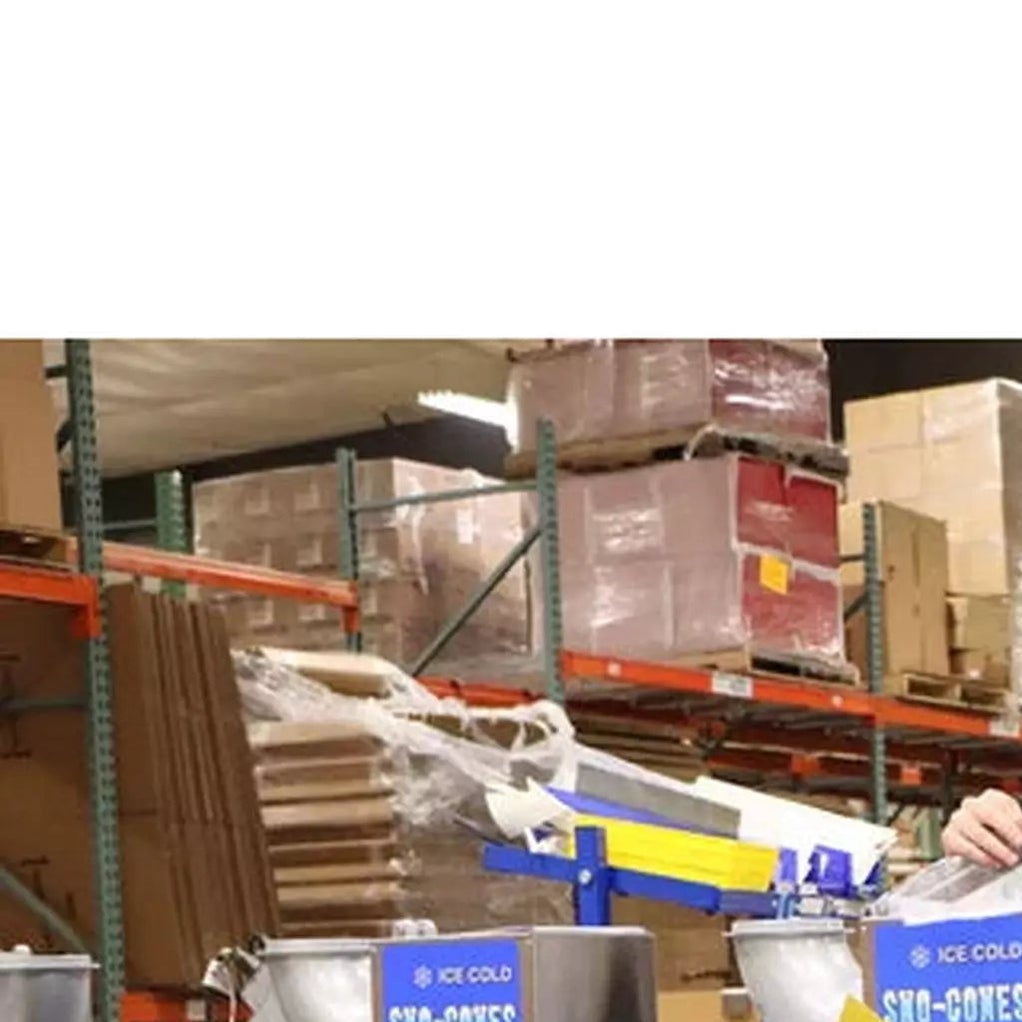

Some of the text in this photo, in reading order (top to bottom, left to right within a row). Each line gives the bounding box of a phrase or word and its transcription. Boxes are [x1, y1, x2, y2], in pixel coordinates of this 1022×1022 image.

[937, 941, 1022, 963] ICE COLD
[437, 965, 513, 984] ICE COLD
